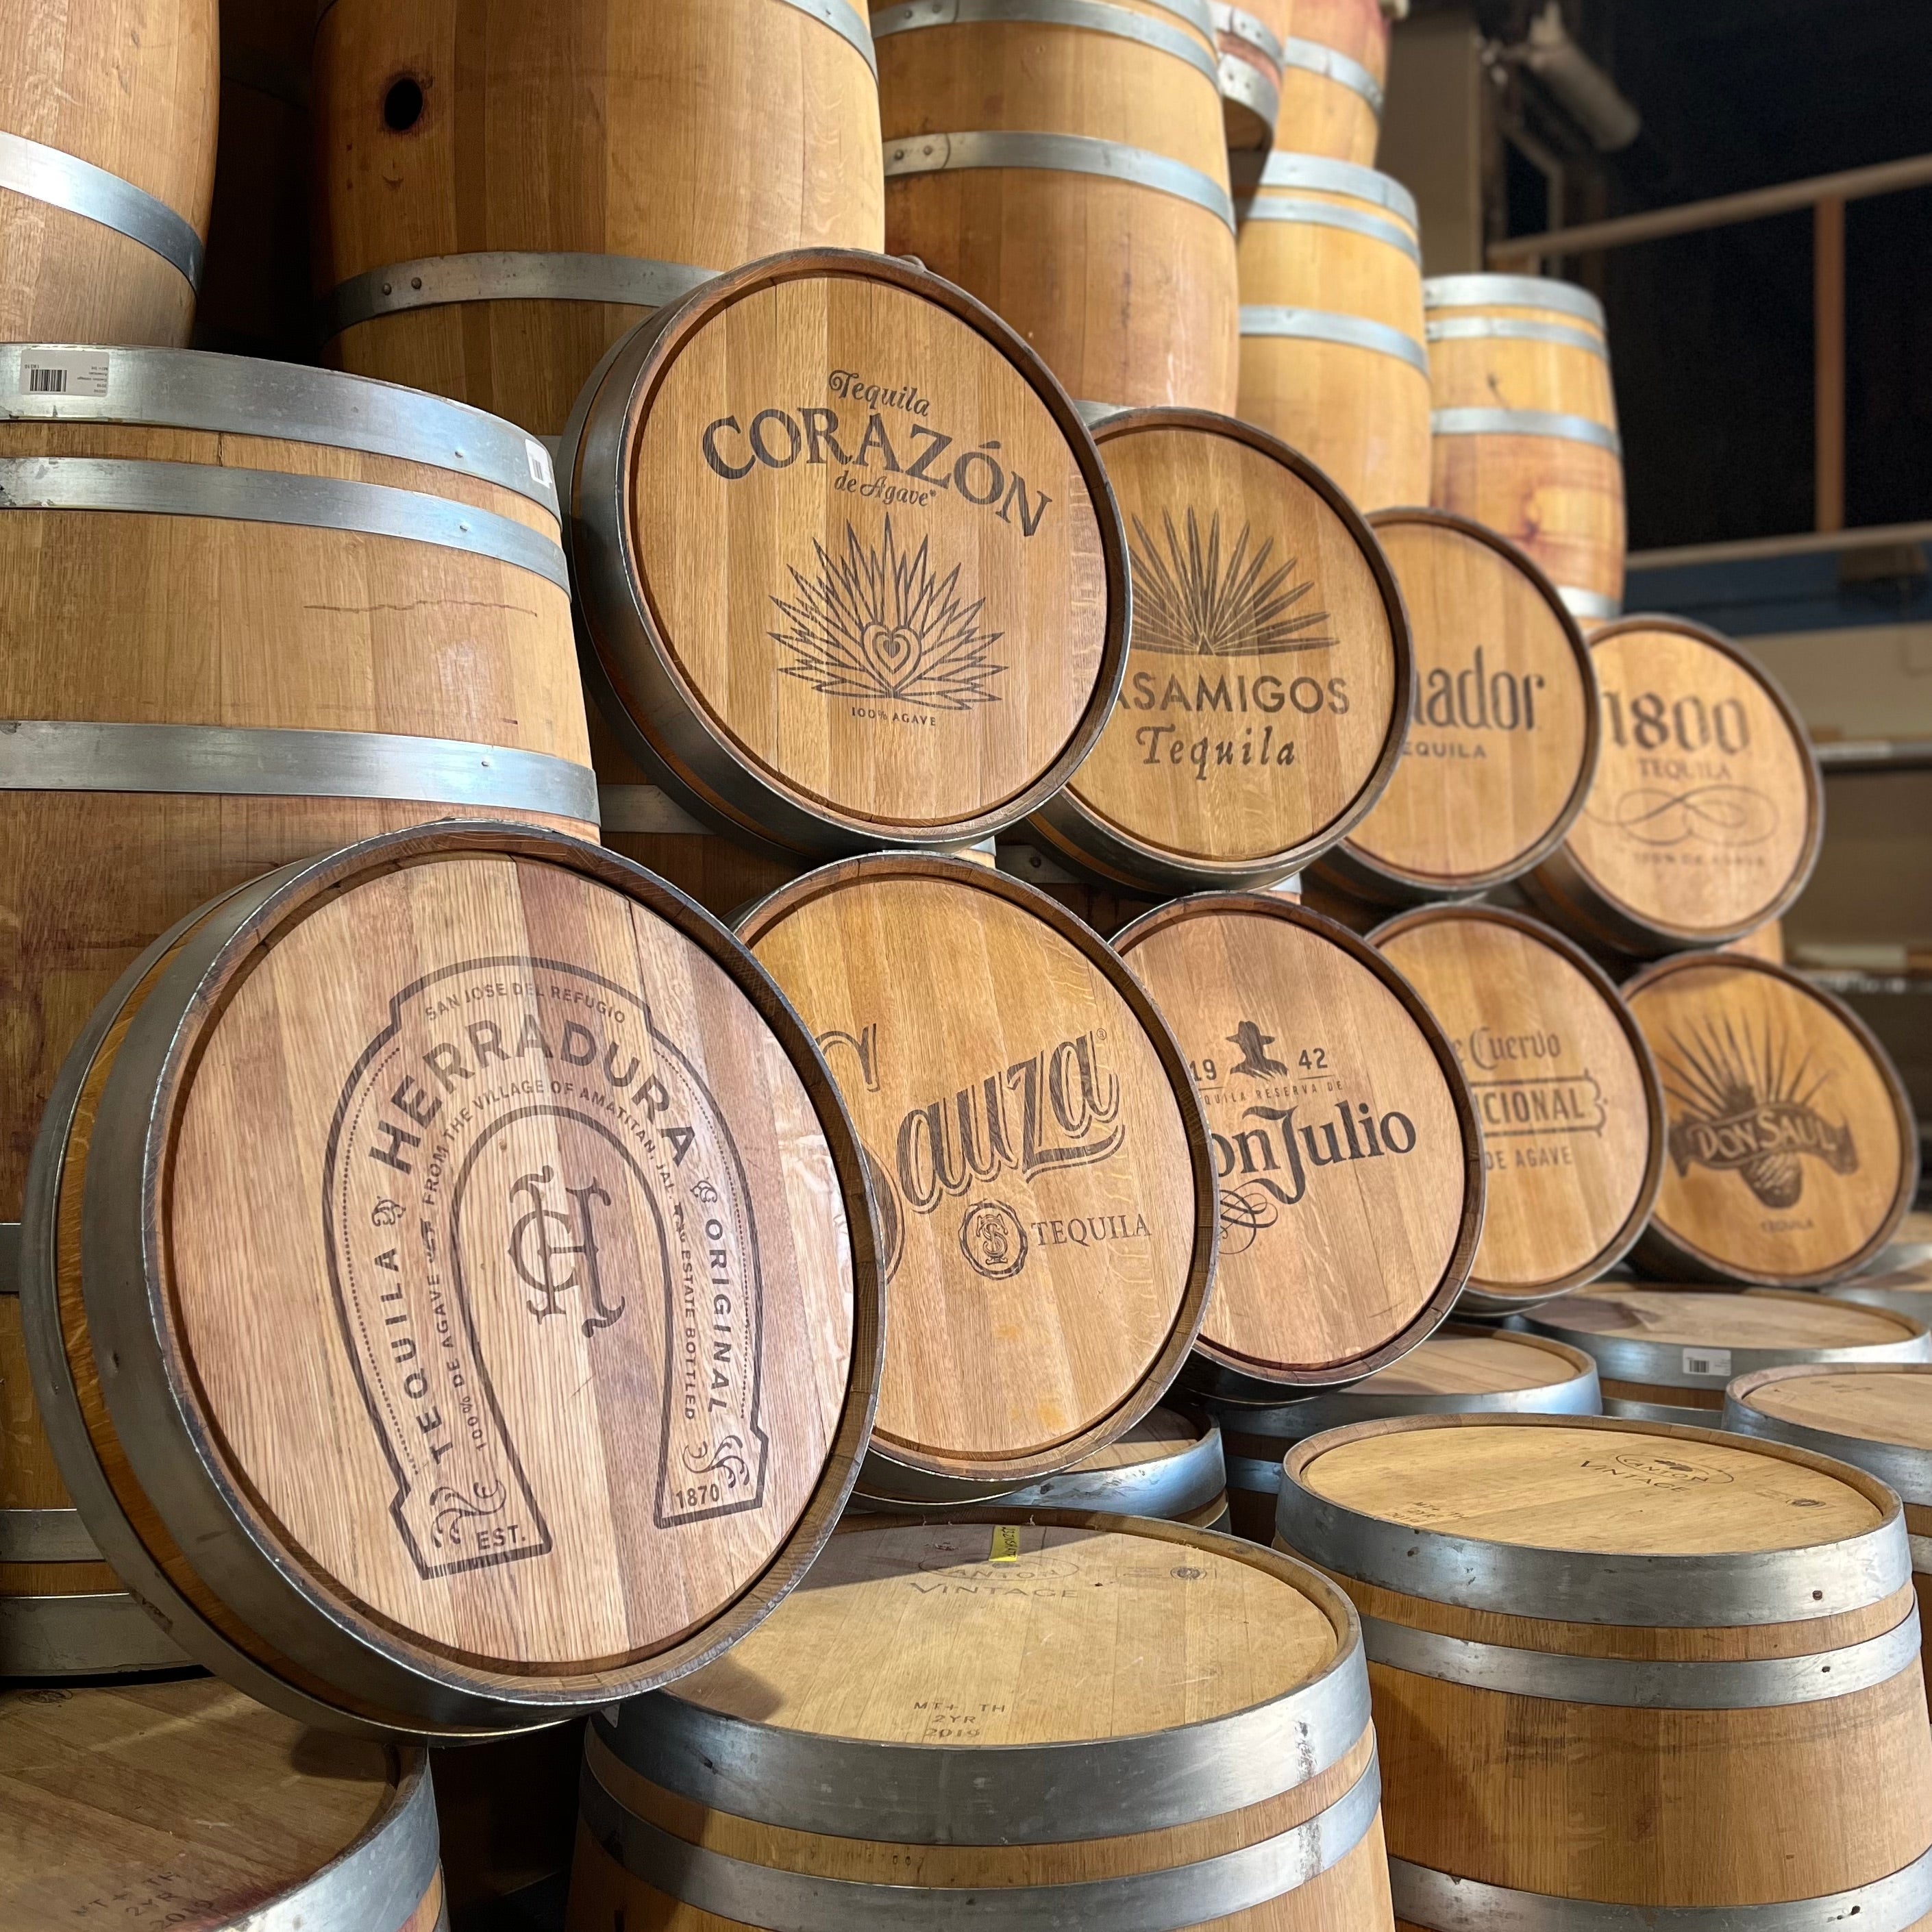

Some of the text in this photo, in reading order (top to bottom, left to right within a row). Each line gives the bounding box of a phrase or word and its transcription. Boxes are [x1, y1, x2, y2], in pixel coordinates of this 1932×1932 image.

[828, 369, 930, 417] Tequila
[702, 407, 1052, 537] CORAZÓN
[834, 470, 856, 492] de
[1414, 645, 1545, 732] ador
[851, 706, 937, 727] 100% AGAVE
[1603, 691, 1750, 756] 1800
[1135, 723, 1295, 780] Tequila
[424, 982, 625, 1024] SAN JOSE DEL REFUGIO
[1190, 1048, 1328, 1081] 19 42
[1470, 1027, 1561, 1070] Cuervo
[369, 1014, 696, 1176] HERRADURA
[1256, 1083, 1318, 1100] RESERVA
[1328, 1080, 1343, 1091] DE
[423, 1144, 448, 1205] FROM
[445, 1108, 474, 1142] THE
[473, 1079, 545, 1111] VILLAGE
[552, 1080, 574, 1095] OF
[655, 1161, 677, 1201] JAL.
[1687, 1109, 1837, 1161] DON SAUL
[1515, 1145, 1572, 1169] AGAVE
[1031, 1214, 1152, 1247] TEQUILA
[680, 1250, 696, 1420] ESTATE BOTTLED
[704, 1219, 732, 1413] ORIGINAL
[374, 1248, 455, 1465] TEQUILA
[427, 1273, 488, 1452] 100% DE AGAVE
[1581, 1461, 1690, 1492] VINTAGE
[1624, 1459, 1709, 1482] CANTON
[676, 1483, 720, 1509] 1870
[478, 1525, 527, 1551] EST.
[910, 1582, 1079, 1598] VINTAGE
[932, 1715, 976, 1724] 2YR
[979, 1703, 1005, 1712] TH
